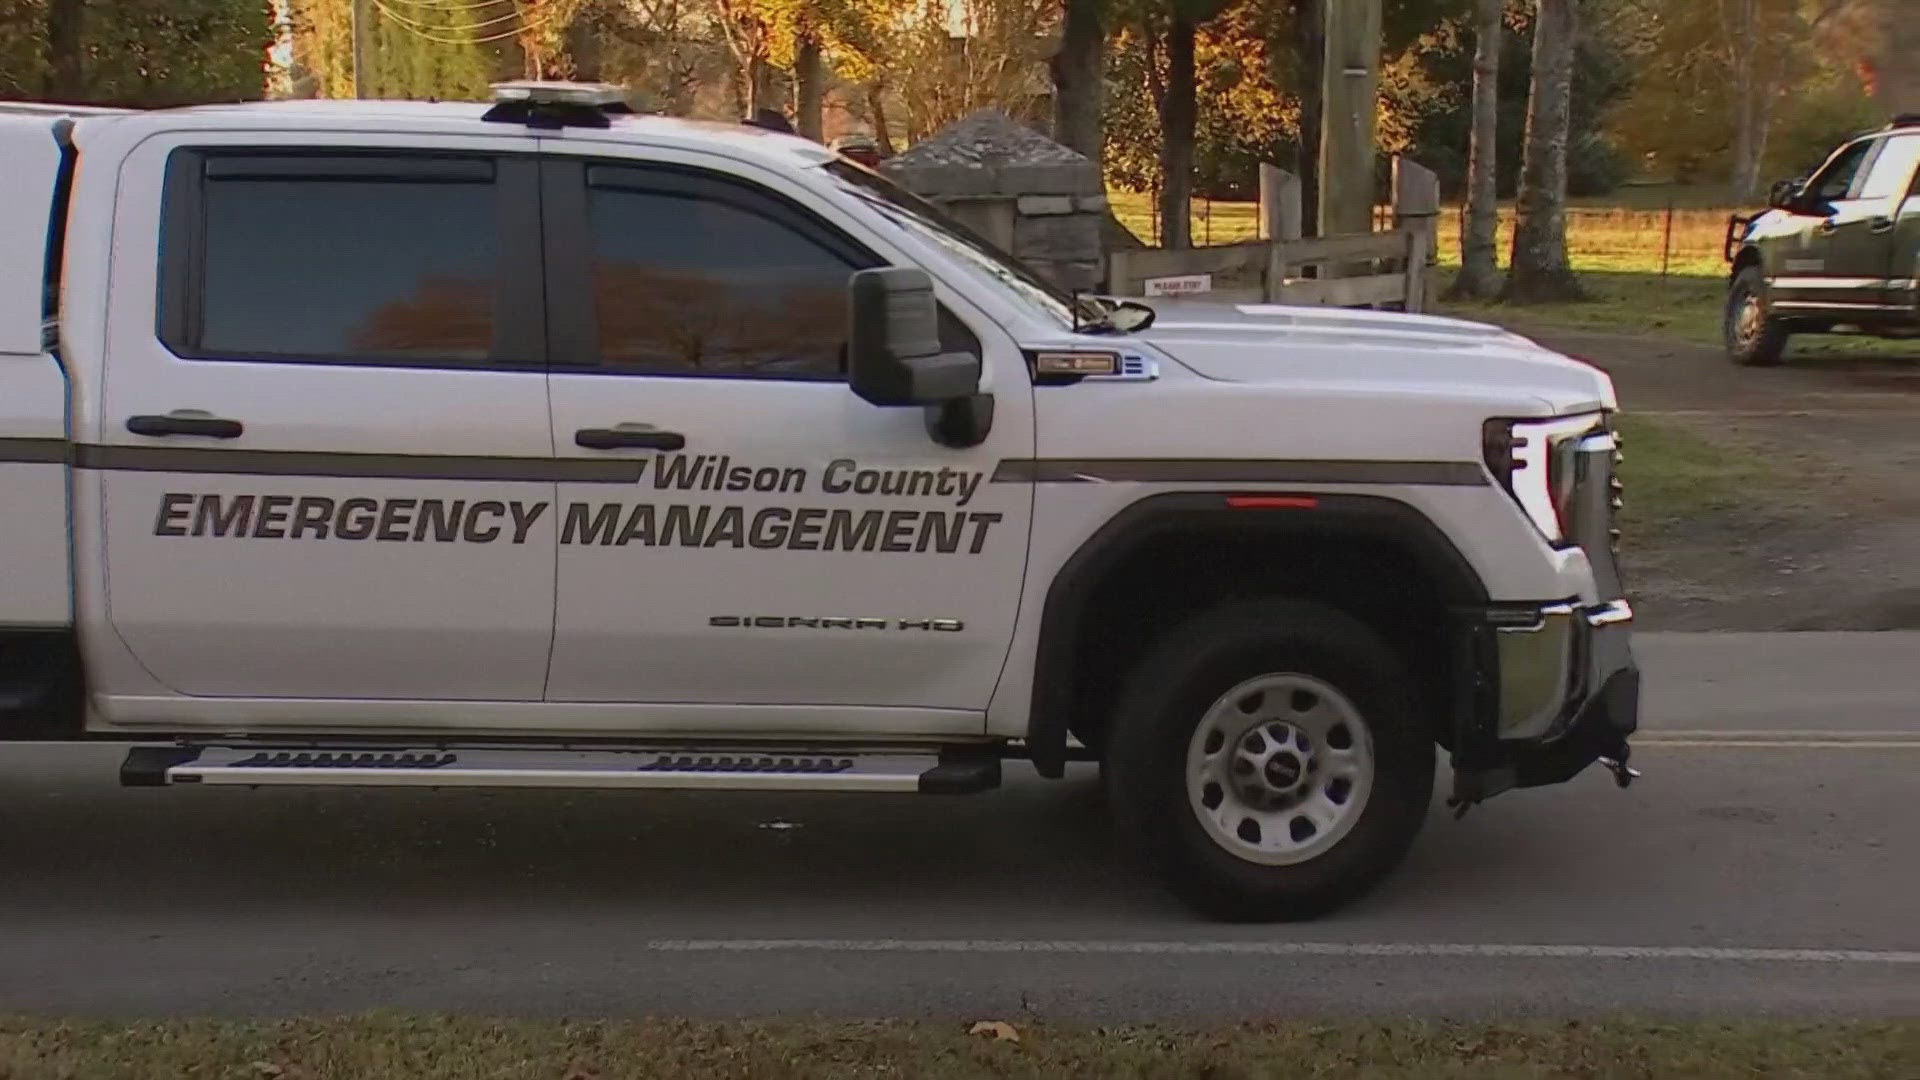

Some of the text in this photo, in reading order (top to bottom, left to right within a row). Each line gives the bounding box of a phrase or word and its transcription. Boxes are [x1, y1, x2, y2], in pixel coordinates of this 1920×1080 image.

[653, 455, 984, 506] Wilson County
[153, 492, 1003, 554] EMERGENCY MANAGEMENT
[708, 615, 965, 632] SIERRA HD
